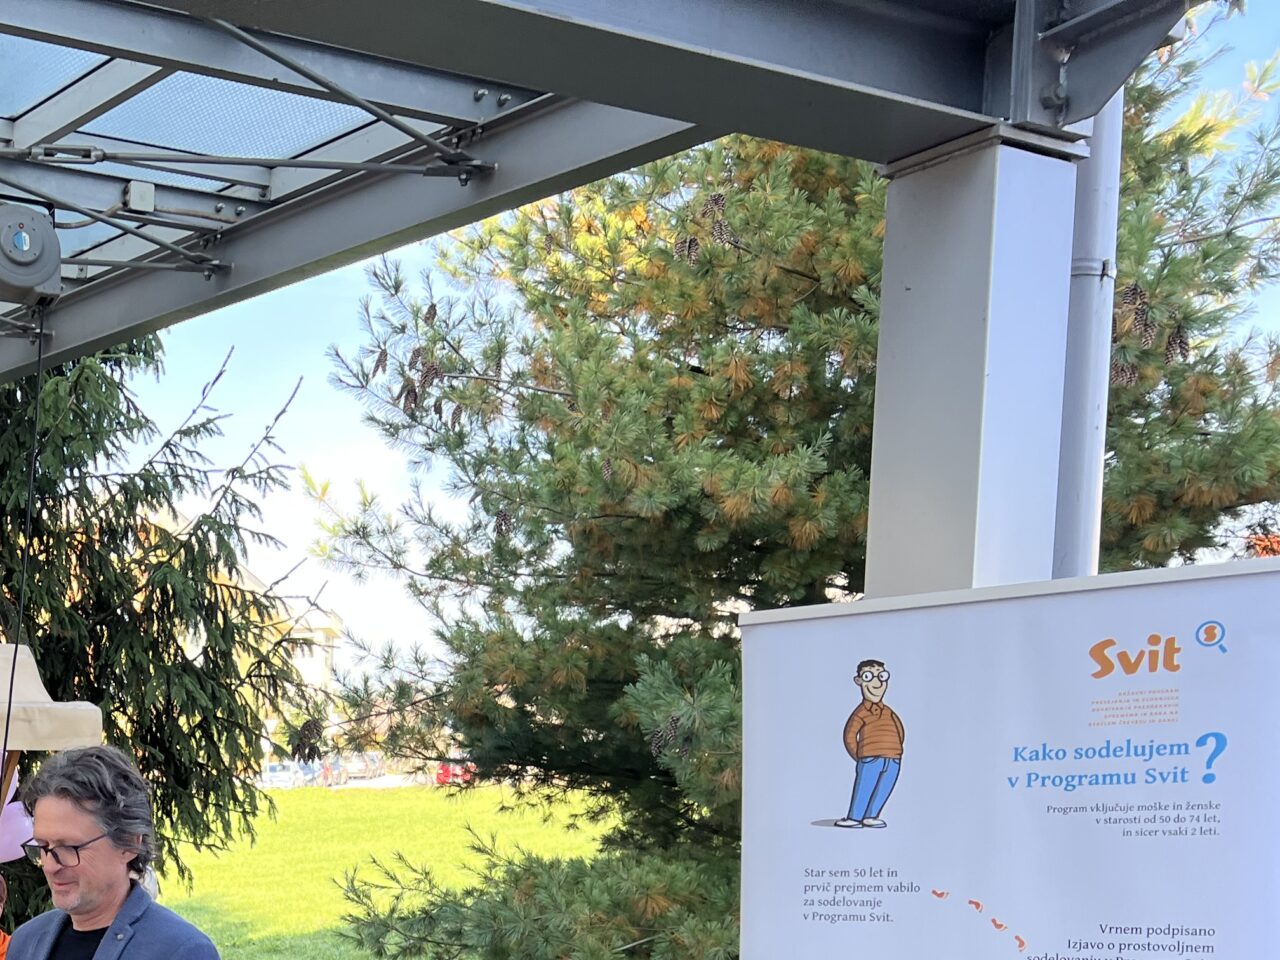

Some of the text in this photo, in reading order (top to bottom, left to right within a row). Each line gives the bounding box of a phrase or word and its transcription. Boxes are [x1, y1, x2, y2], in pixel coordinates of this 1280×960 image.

[1089, 634, 1182, 679] Svit
[1013, 732, 1227, 784] Kako sodelujem ?
[1008, 767, 1189, 791] v Programu Svit
[1047, 800, 1220, 815] Program vključuje moške in ženske
[1104, 815, 1141, 824] starosti
[1144, 815, 1156, 824] od
[1173, 815, 1186, 823] do
[1204, 814, 1220, 824] let,
[1123, 827, 1219, 837] in sicer vsaki 2 leti.
[804, 867, 898, 878] Star sem 50 let in
[804, 882, 920, 894] prvič prejmem vabilo
[818, 897, 882, 909] sodelovanje
[812, 912, 866, 924] Programu
[870, 912, 893, 922] Svit.
[1099, 924, 1215, 938] Vrnem podpisano
[1068, 939, 1214, 955] Izjavo o prostovoljnem
